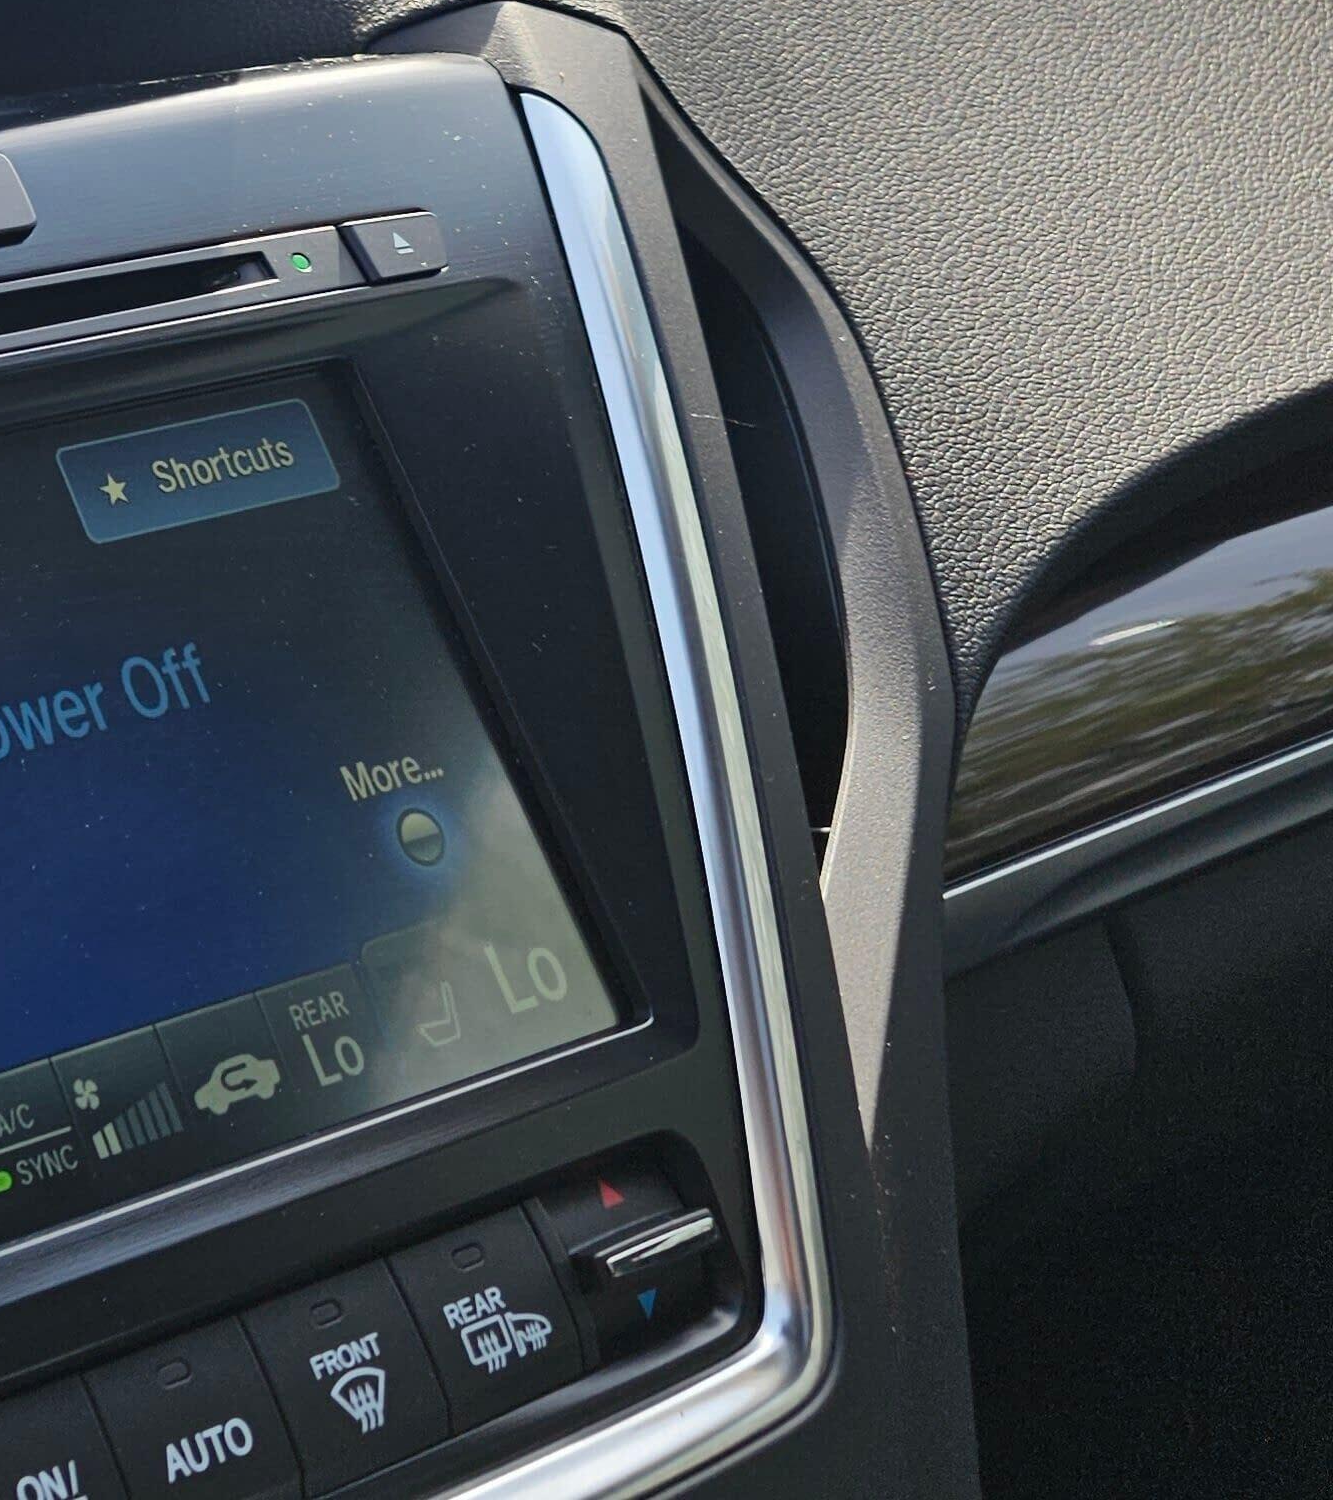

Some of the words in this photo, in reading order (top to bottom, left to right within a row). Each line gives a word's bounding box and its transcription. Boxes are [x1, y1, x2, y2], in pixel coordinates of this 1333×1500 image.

[151, 436, 296, 494] Shortcuts
[119, 642, 212, 721] Off
[289, 991, 350, 1031] REAR
[16, 1146, 79, 1186] SYNC
[443, 1286, 507, 1329] REAR
[309, 1332, 382, 1381] FRONT
[164, 1417, 254, 1484] AUTO
